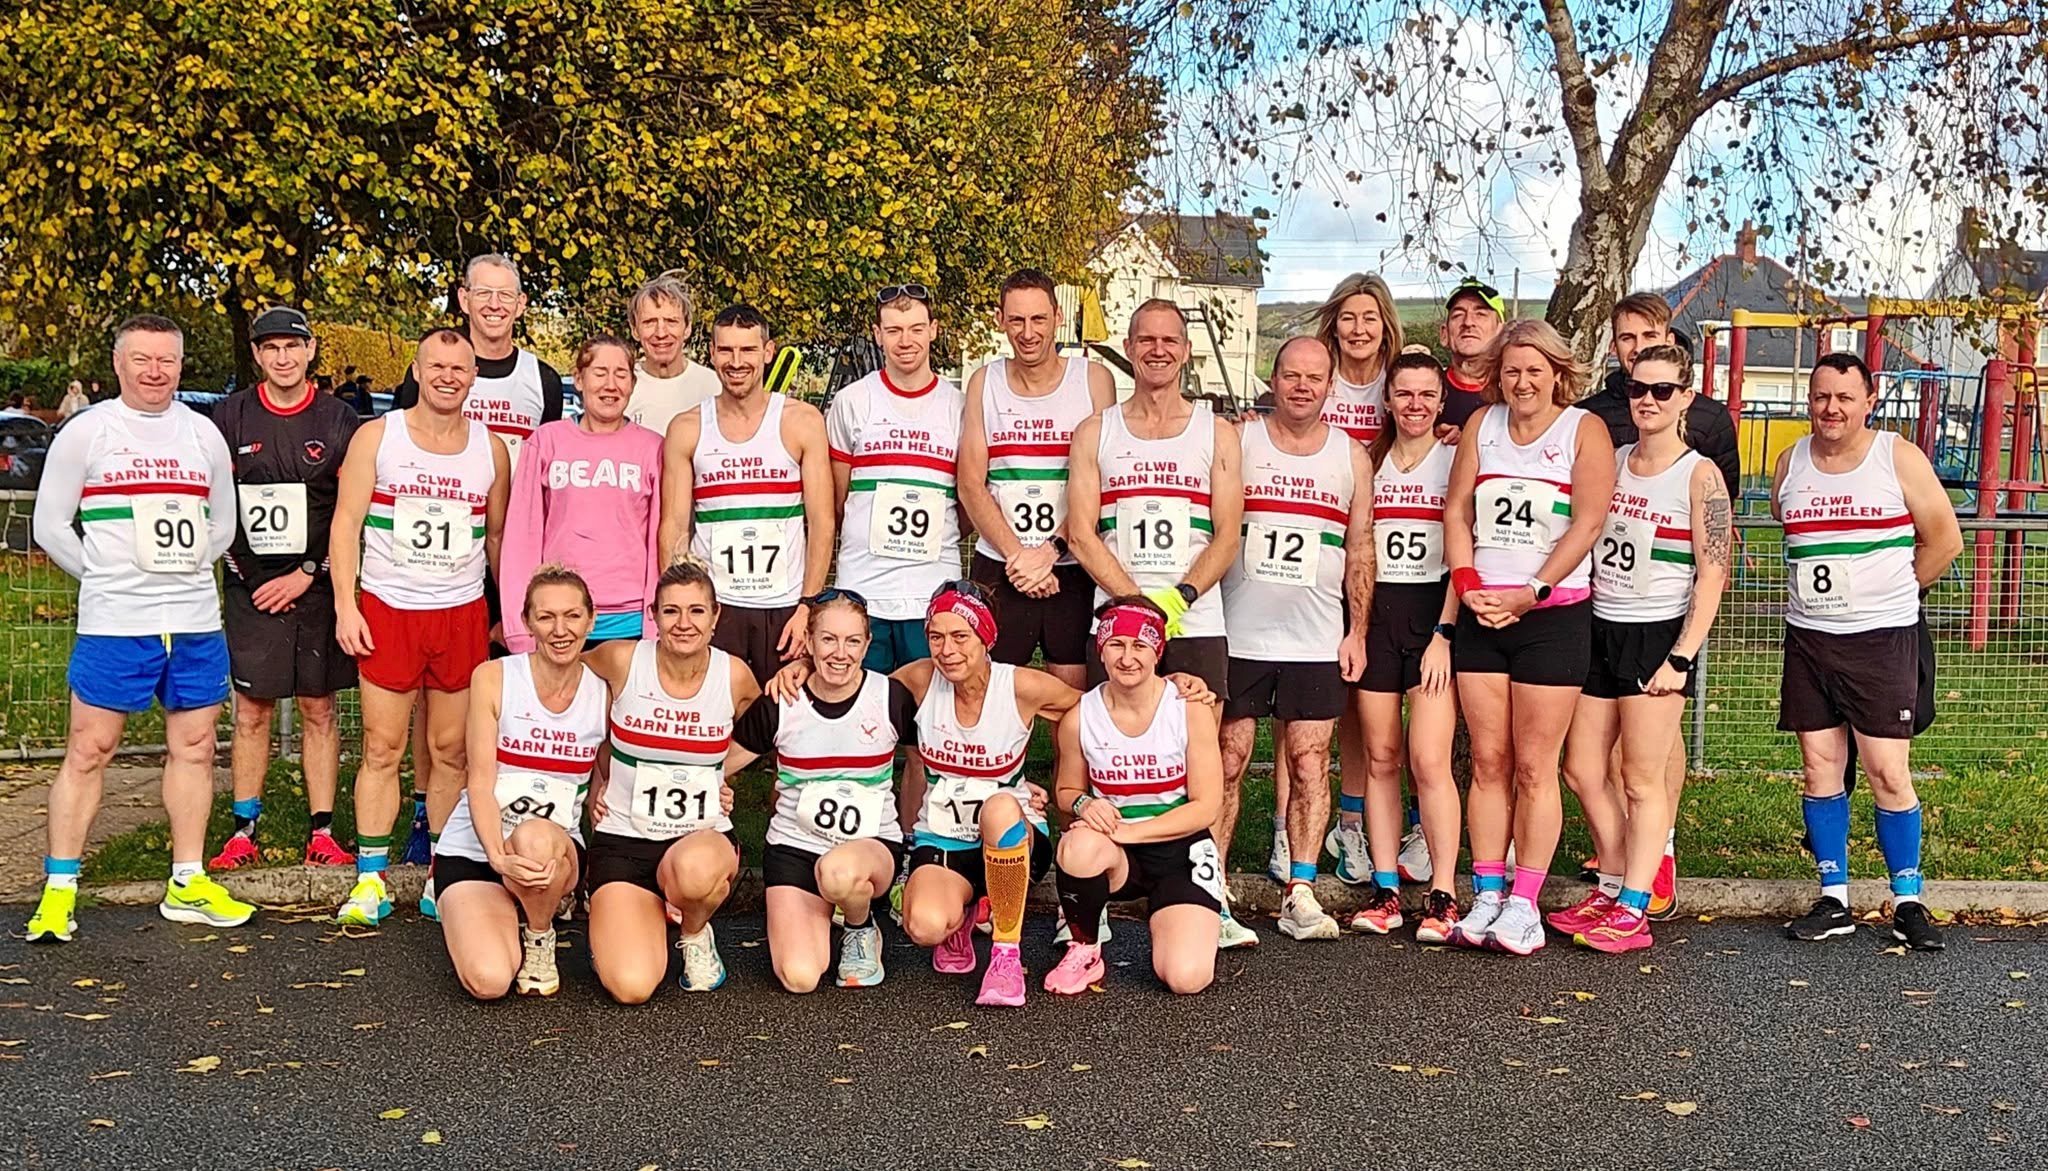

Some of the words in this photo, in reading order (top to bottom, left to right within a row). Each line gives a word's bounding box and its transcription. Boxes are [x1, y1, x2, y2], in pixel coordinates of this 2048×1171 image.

[470, 399, 512, 410] CLWB
[1336, 403, 1376, 414] CLWB
[464, 410, 482, 422] RN
[488, 412, 531, 426] HELEN
[1014, 419, 1054, 430] CLWB
[1320, 412, 1349, 424] ARN
[1354, 416, 1384, 427] HEL
[890, 429, 930, 440] CLWB
[992, 431, 1027, 442] SARN
[864, 441, 903, 452] SARN
[908, 441, 954, 459] HELEN
[132, 458, 180, 468] CLWB
[721, 457, 764, 468] CLWB
[1133, 462, 1178, 472] CLWB
[104, 470, 150, 483] SARN
[156, 470, 207, 482] HELEN
[417, 473, 462, 488] CLWB
[549, 458, 642, 493] BEAR
[702, 470, 736, 483] SARN
[742, 469, 788, 480] HELEN
[1108, 474, 1148, 488] SARN
[1154, 474, 1202, 488] HELEN
[1272, 475, 1315, 488] CLWB
[388, 483, 432, 496] SARN
[437, 488, 486, 504] HELEN
[1244, 485, 1285, 498] SARN
[1290, 488, 1340, 506] HELEN
[1382, 484, 1424, 493] CLWB
[1374, 494, 1390, 504] RN
[1612, 492, 1648, 508] CLWB
[1811, 496, 1853, 506] CLWB
[248, 505, 288, 532] 20
[1014, 502, 1055, 532] 38
[1494, 496, 1536, 528] 24
[1623, 506, 1672, 525] HELEN
[1786, 508, 1824, 520] SARN
[1829, 507, 1882, 517] HELEN
[888, 506, 930, 538] 39
[154, 518, 195, 548] 90
[412, 520, 450, 550] 31
[1132, 518, 1174, 550] 18
[1264, 530, 1304, 562] 12
[1386, 531, 1427, 562] 65
[1601, 537, 1636, 572] 29
[720, 545, 780, 574] 117
[1812, 564, 1832, 594] 8
[653, 707, 700, 723] CLWB
[624, 715, 668, 733] SARN
[674, 724, 724, 736] HELEN
[530, 728, 577, 743] CLWB
[502, 736, 545, 754] SARN
[552, 744, 597, 758] HELEN
[921, 742, 956, 764] SARN
[962, 750, 1014, 768] HELEN
[944, 740, 986, 754] CLWB
[1112, 754, 1158, 766] CLWB
[1092, 768, 1128, 781] SARN
[1134, 763, 1184, 780] HELEN
[642, 786, 708, 820] 131
[944, 799, 984, 824] 17
[814, 798, 862, 836] 80
